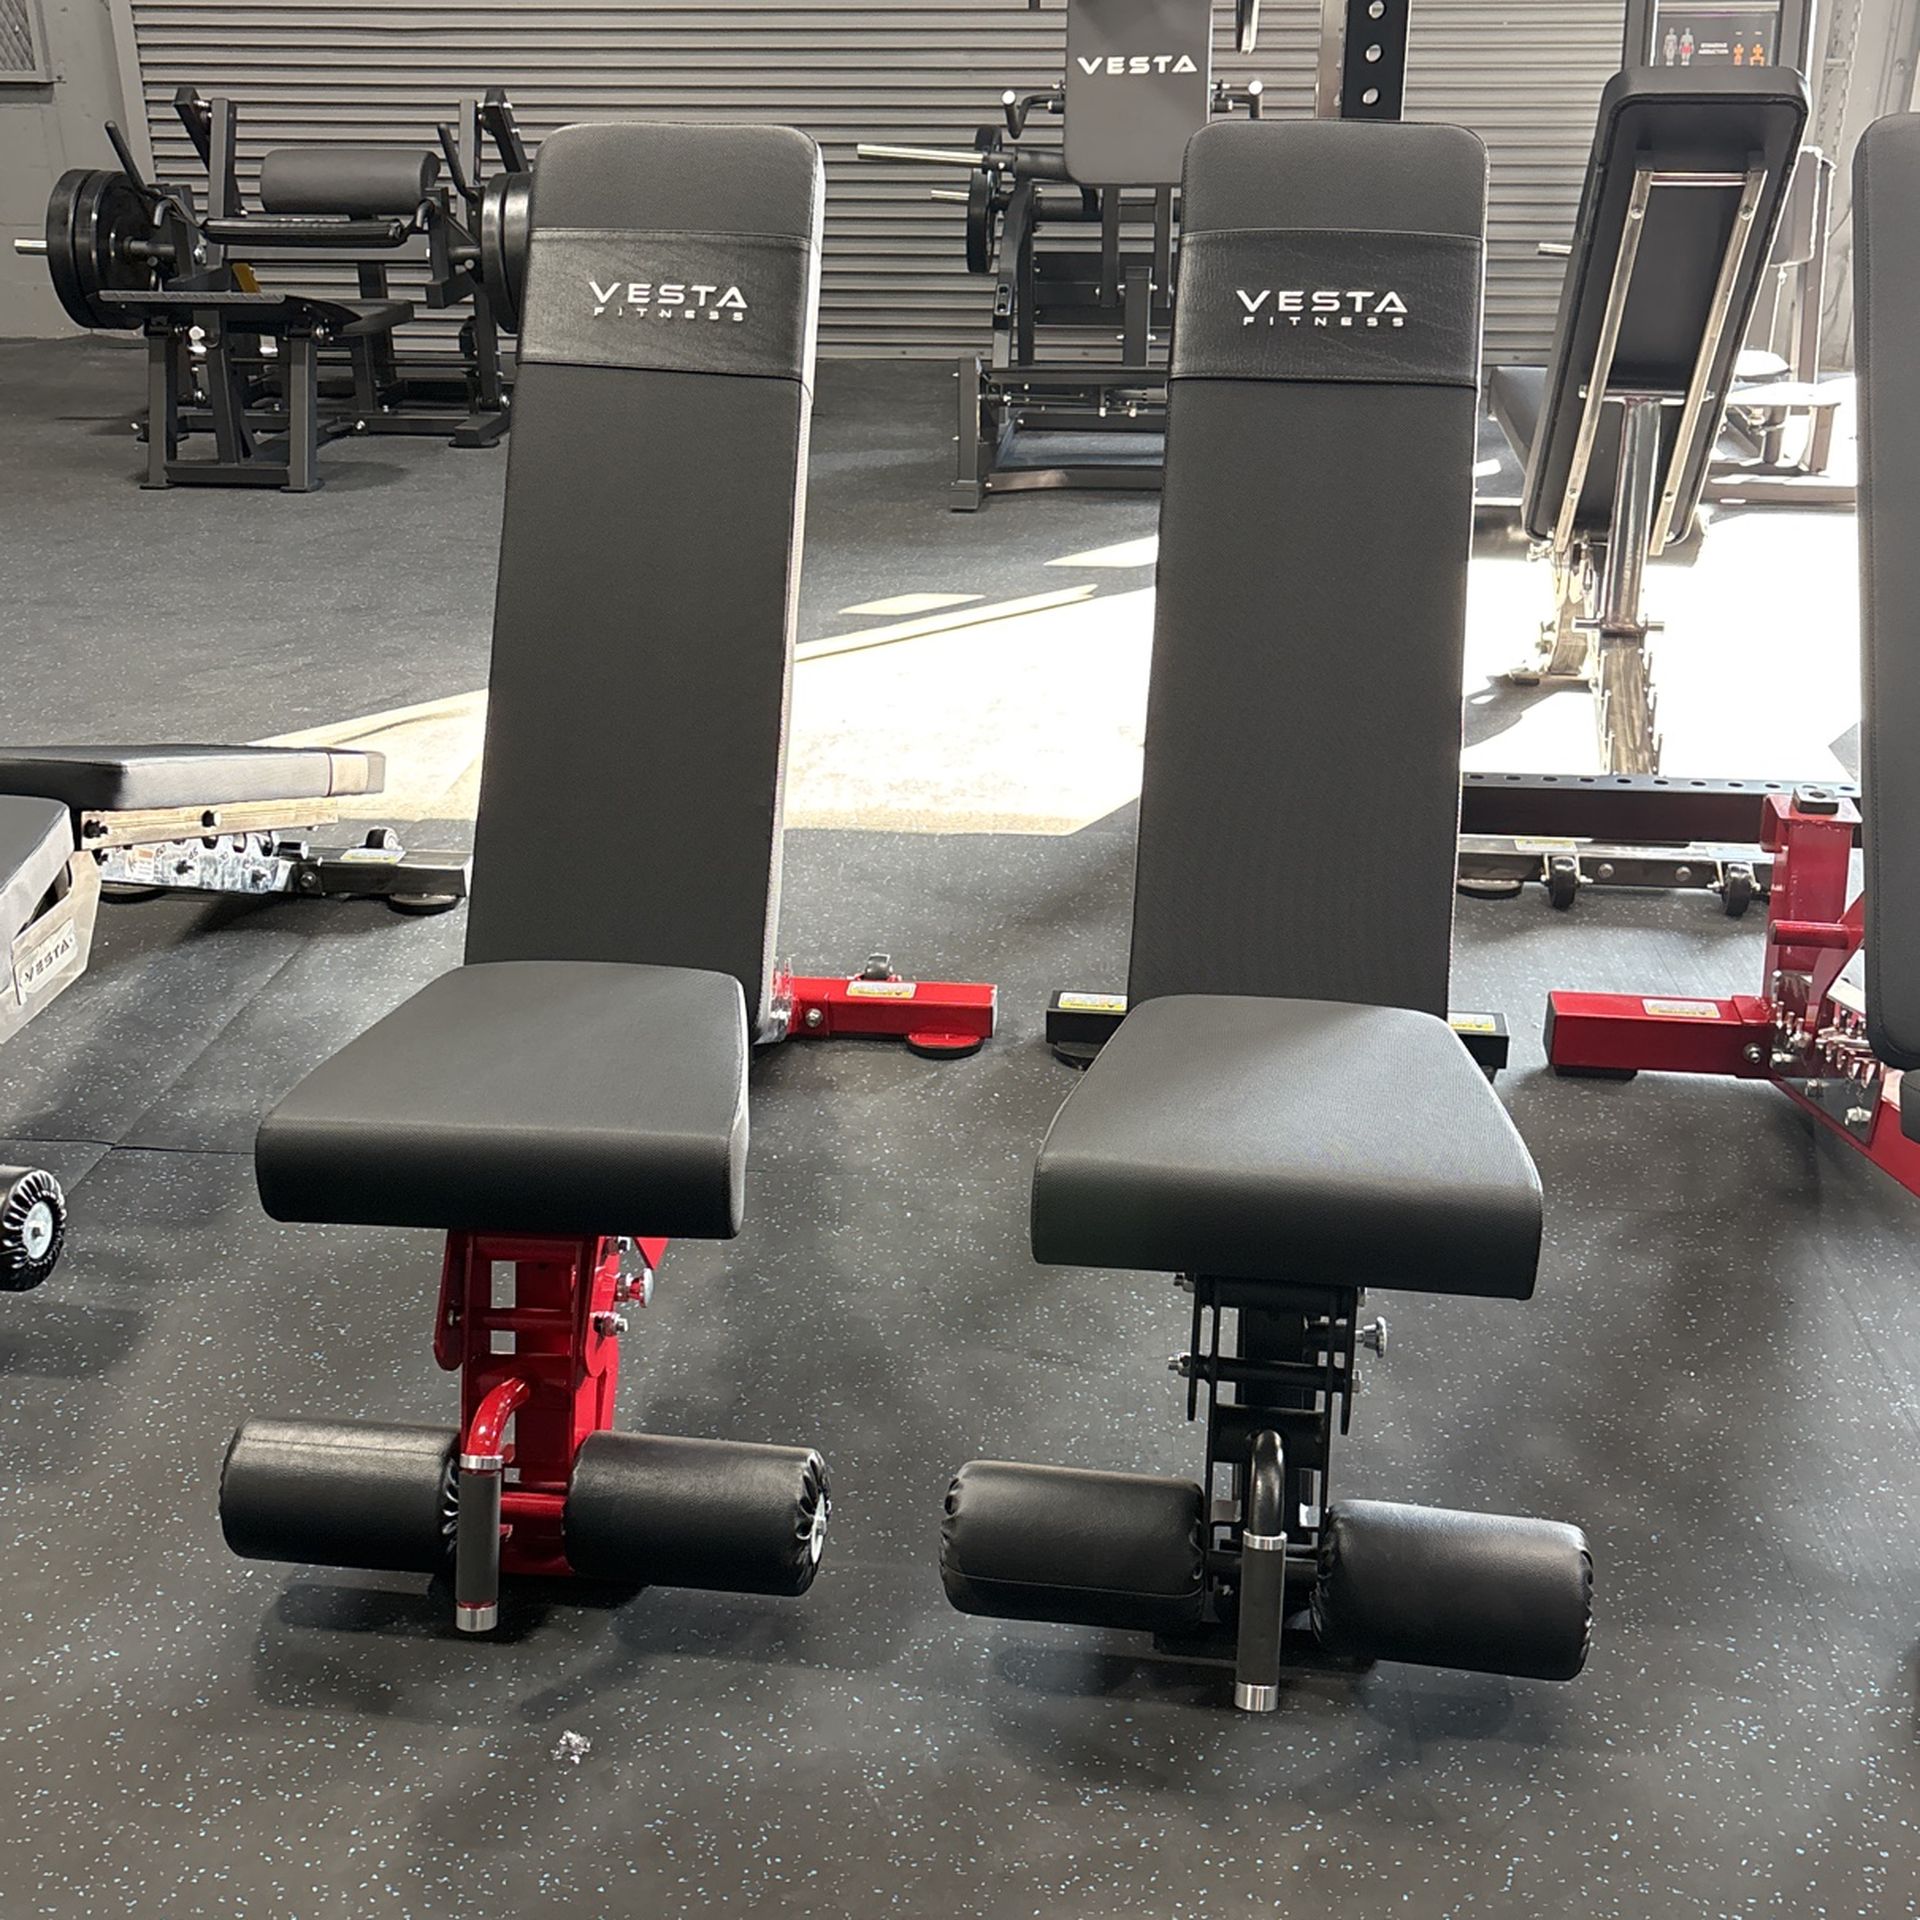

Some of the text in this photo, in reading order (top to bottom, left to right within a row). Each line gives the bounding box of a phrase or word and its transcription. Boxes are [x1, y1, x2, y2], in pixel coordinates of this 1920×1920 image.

[1077, 54, 1198, 75] VESTA
[588, 280, 748, 309] VESTA
[1236, 290, 1408, 313] VESTA
[593, 306, 744, 322] FITNESS
[1243, 316, 1404, 328] FITNESS
[24, 939, 70, 982] VESTA
